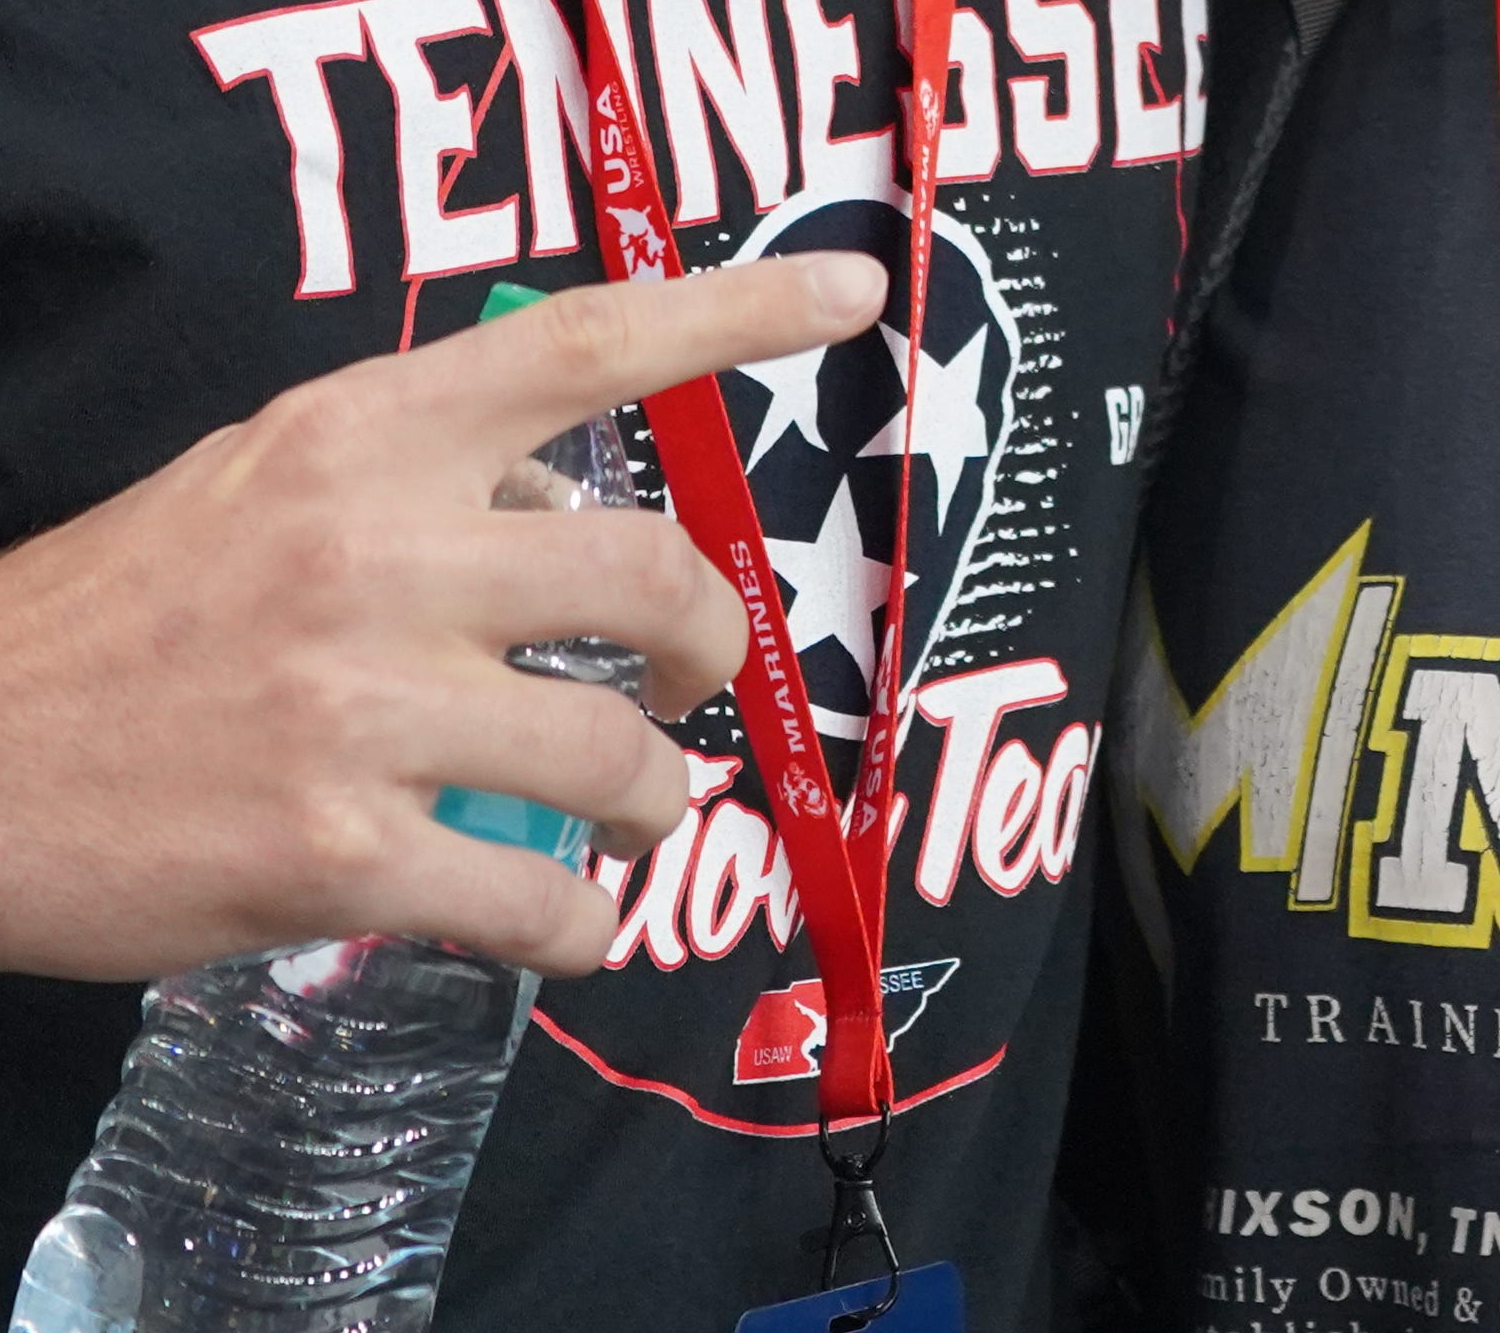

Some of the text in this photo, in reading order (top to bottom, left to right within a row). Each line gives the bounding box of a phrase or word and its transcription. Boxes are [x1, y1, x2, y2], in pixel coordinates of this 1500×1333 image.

[596, 83, 632, 195] USA
[609, 80, 645, 188] WRESTLING
[729, 539, 806, 754] MARINES
[859, 729, 887, 837] USA
[914, 655, 1102, 907] Tea
[753, 1045, 793, 1066] USAW
[1205, 1187, 1428, 1255] IXSON,
[1318, 1266, 1440, 1317] Owned
[1453, 1286, 1483, 1324] &
